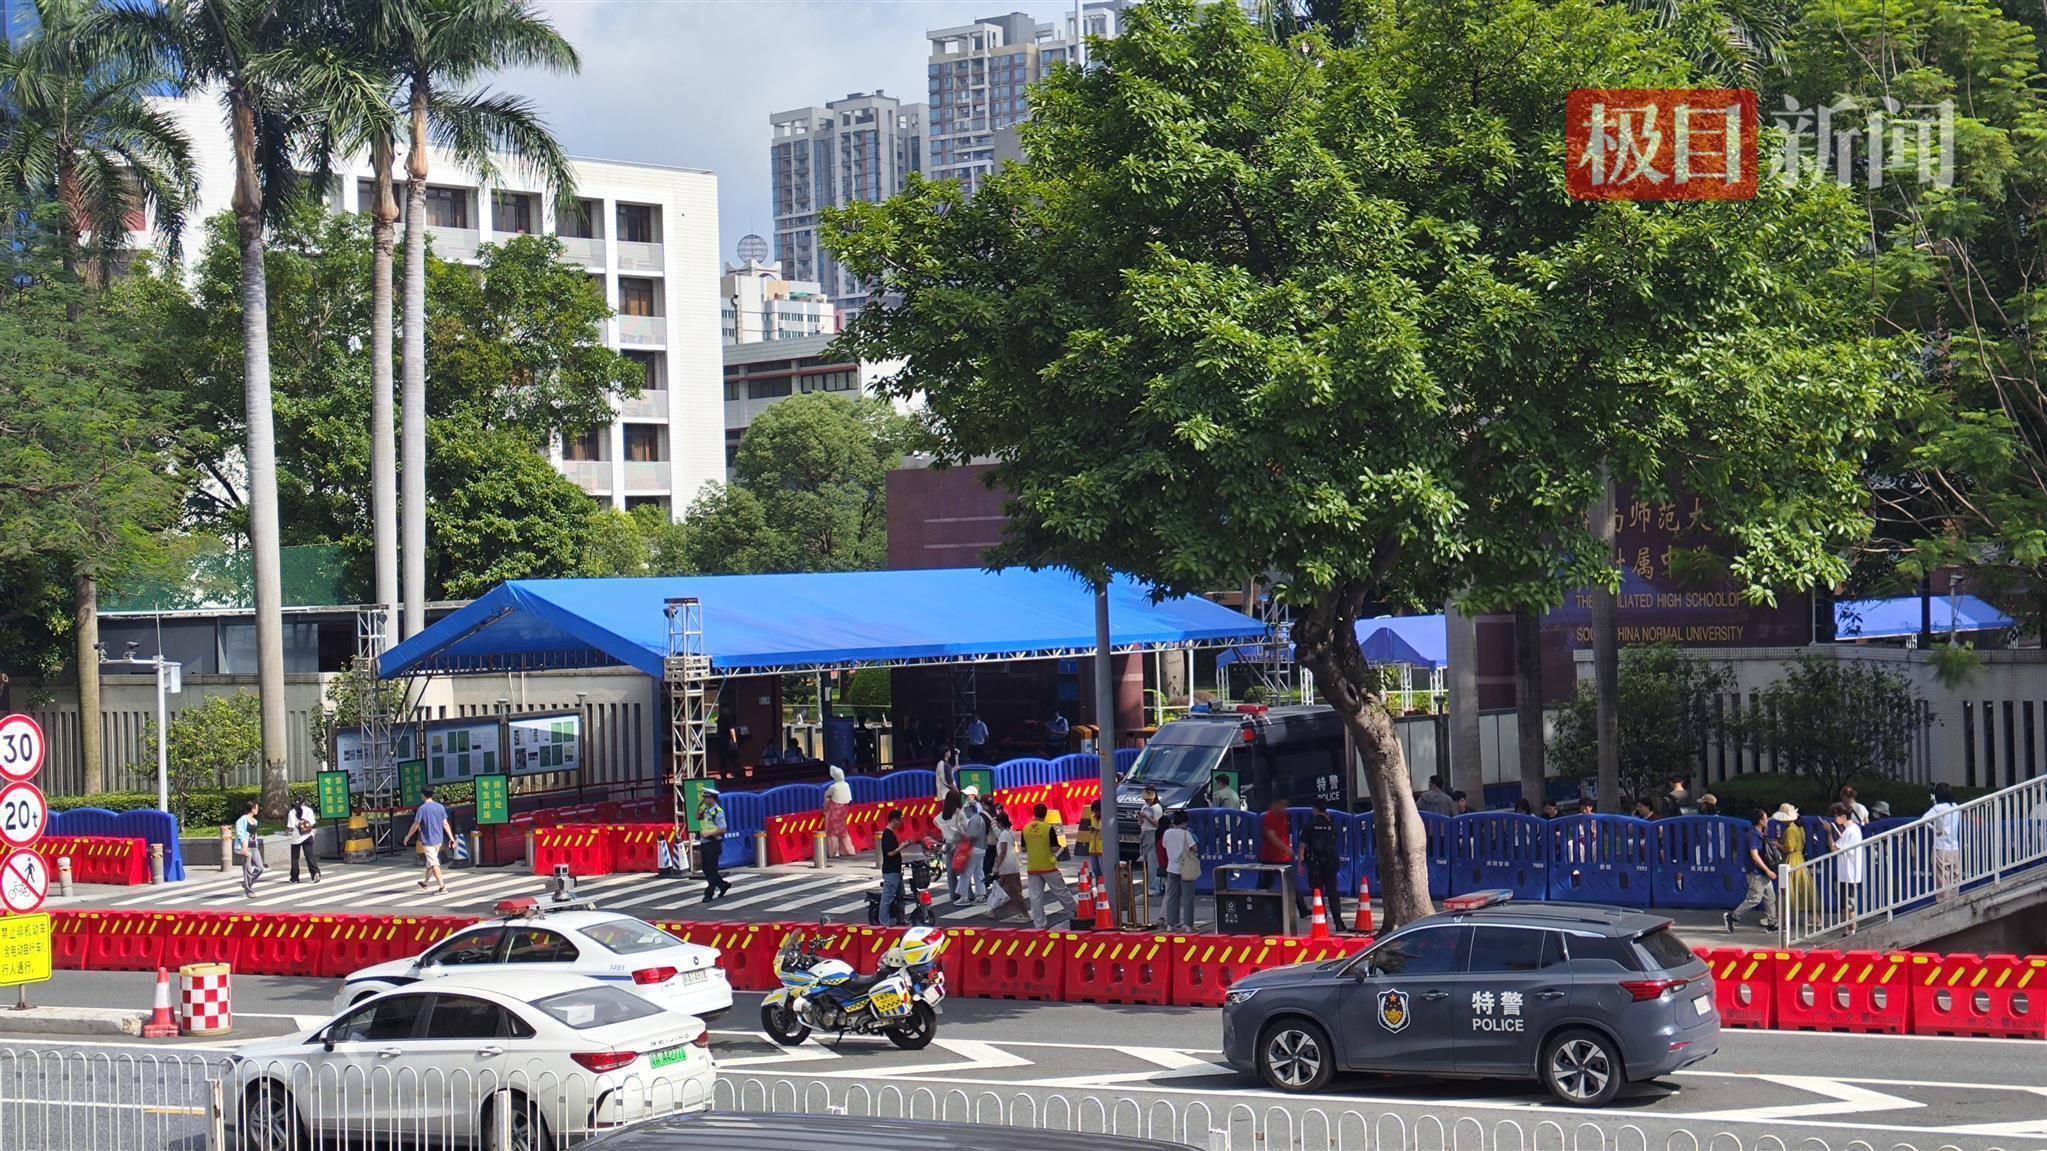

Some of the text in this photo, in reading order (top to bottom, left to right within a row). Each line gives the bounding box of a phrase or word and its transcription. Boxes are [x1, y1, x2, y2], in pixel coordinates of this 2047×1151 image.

[1616, 593, 1653, 608] ILIATED
[1657, 593, 1682, 608] HIGH
[1685, 592, 1728, 608] SCHOOL
[1617, 626, 1640, 641] HINA
[1642, 626, 1683, 641] NORMAL
[1686, 626, 1743, 641] UNIVERSITY
[3, 733, 33, 763] 30
[1471, 990, 1524, 1016] 特警
[1472, 1018, 1525, 1032] POLICE
